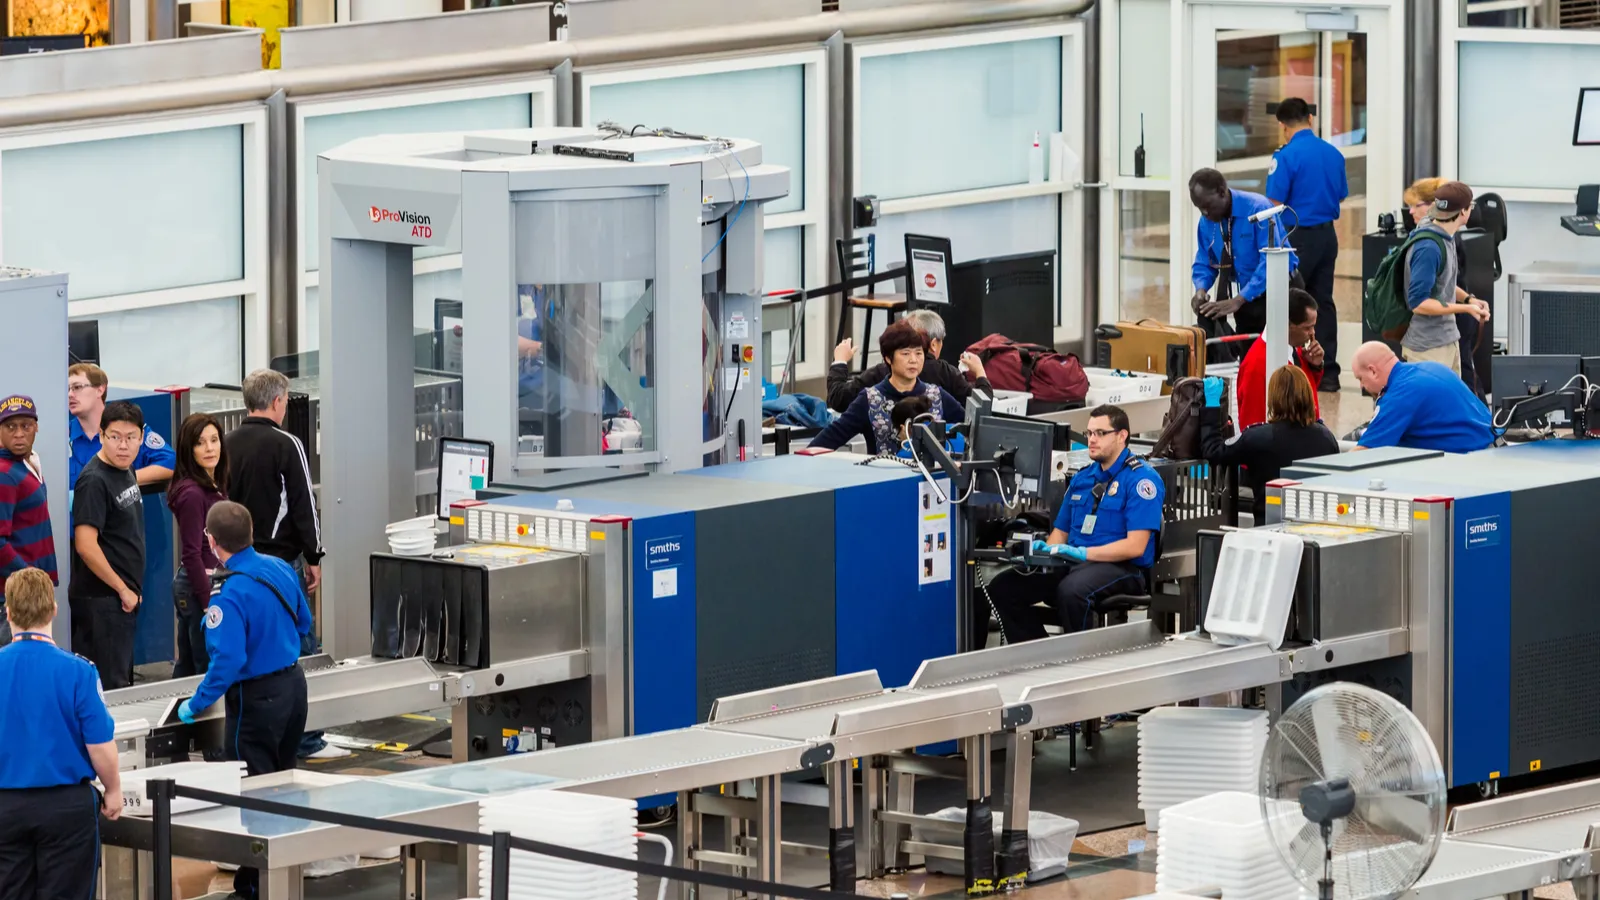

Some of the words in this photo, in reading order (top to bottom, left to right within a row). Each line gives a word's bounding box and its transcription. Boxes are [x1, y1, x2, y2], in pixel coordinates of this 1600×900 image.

[381, 208, 431, 225] ProVision
[411, 225, 432, 238] ATD
[7, 396, 33, 409] ANGELES
[1469, 521, 1498, 535] smiths
[649, 541, 681, 555] smiths
